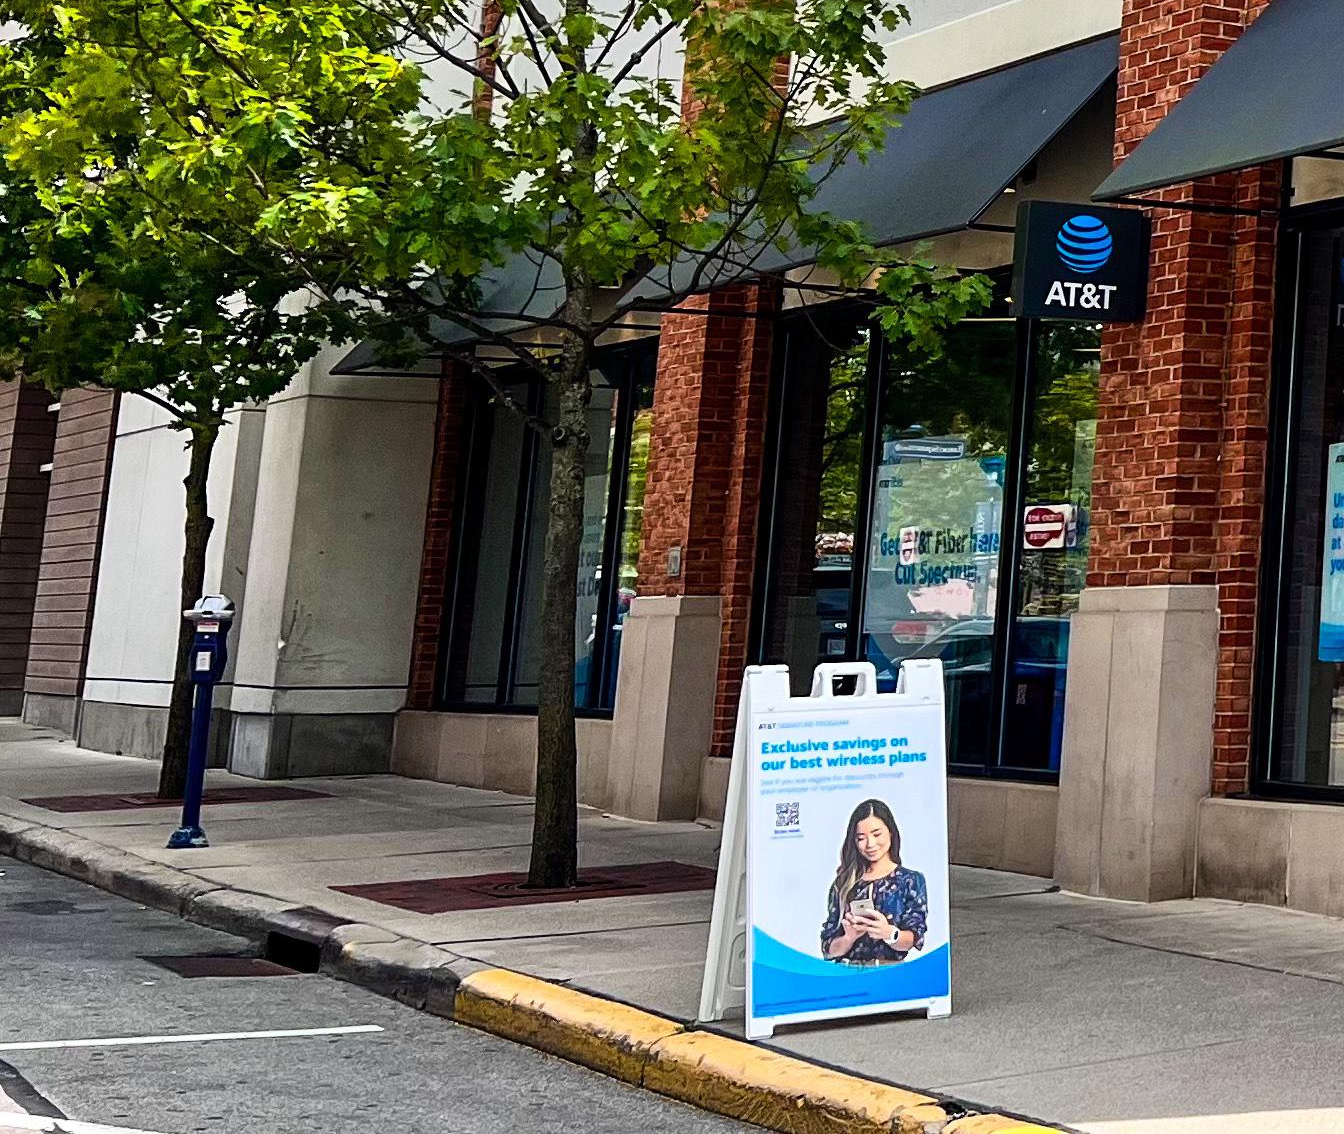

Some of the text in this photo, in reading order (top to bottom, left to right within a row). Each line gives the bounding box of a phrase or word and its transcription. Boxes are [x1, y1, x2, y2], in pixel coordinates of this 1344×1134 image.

[1045, 281, 1117, 309] AT&T
[935, 526, 968, 555] Fiber
[1331, 536, 1341, 550] at
[895, 562, 916, 585] Cut
[761, 736, 908, 754] Exclusive savings on
[761, 751, 927, 771] our best wireless plans
